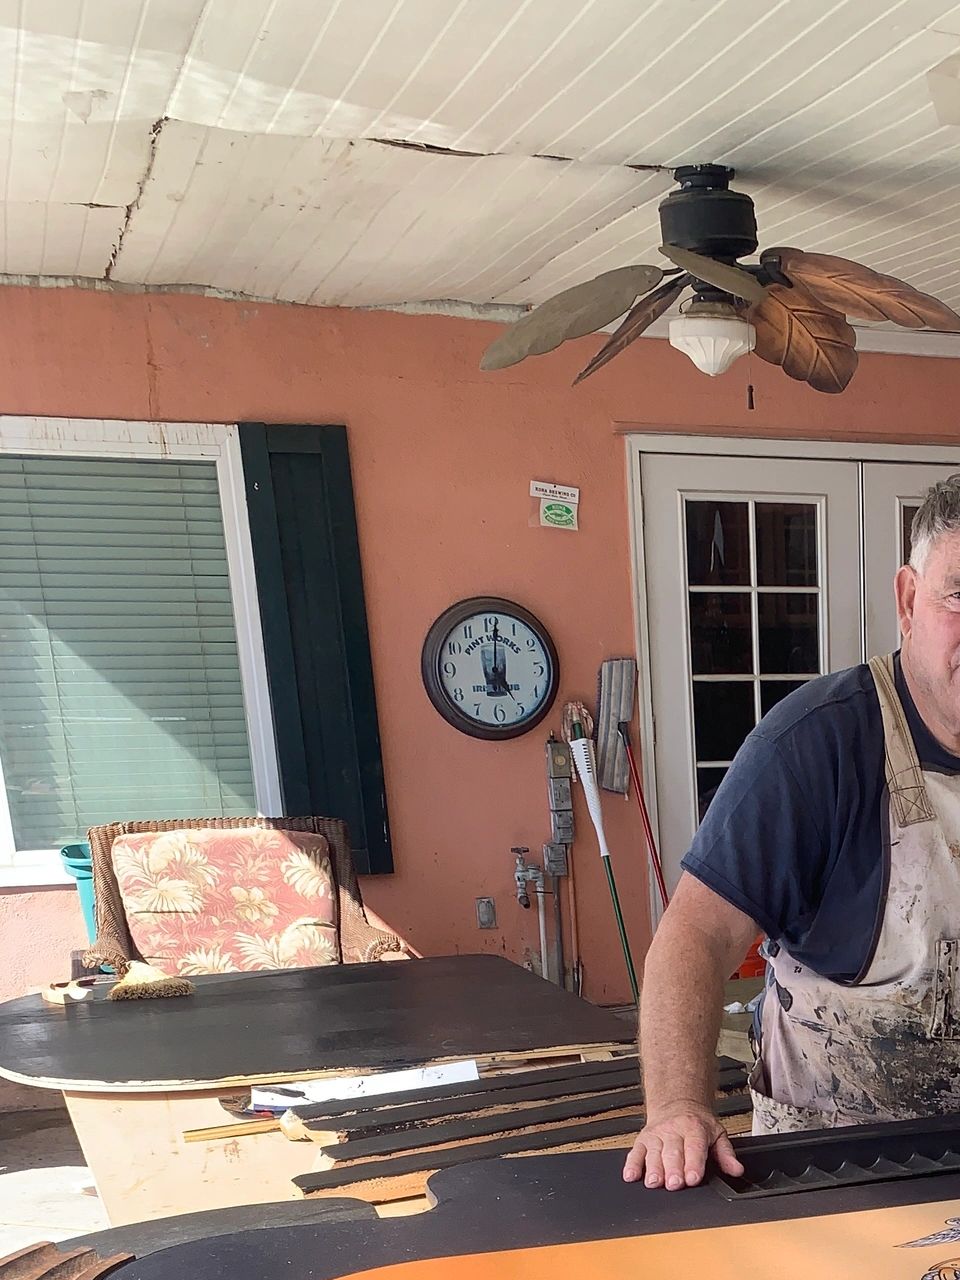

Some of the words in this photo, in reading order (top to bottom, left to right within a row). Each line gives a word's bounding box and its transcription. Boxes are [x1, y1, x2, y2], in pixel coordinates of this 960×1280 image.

[463, 625, 472, 639] 11
[448, 641, 462, 656] 10
[465, 636, 484, 656] PINT
[486, 634, 521, 655] WORKS
[526, 638, 536, 652] 2
[444, 662, 457, 679] 9
[454, 688, 465, 702] 8
[474, 704, 482, 716] 7
[494, 704, 506, 722] 6
[516, 702, 525, 716] 5
